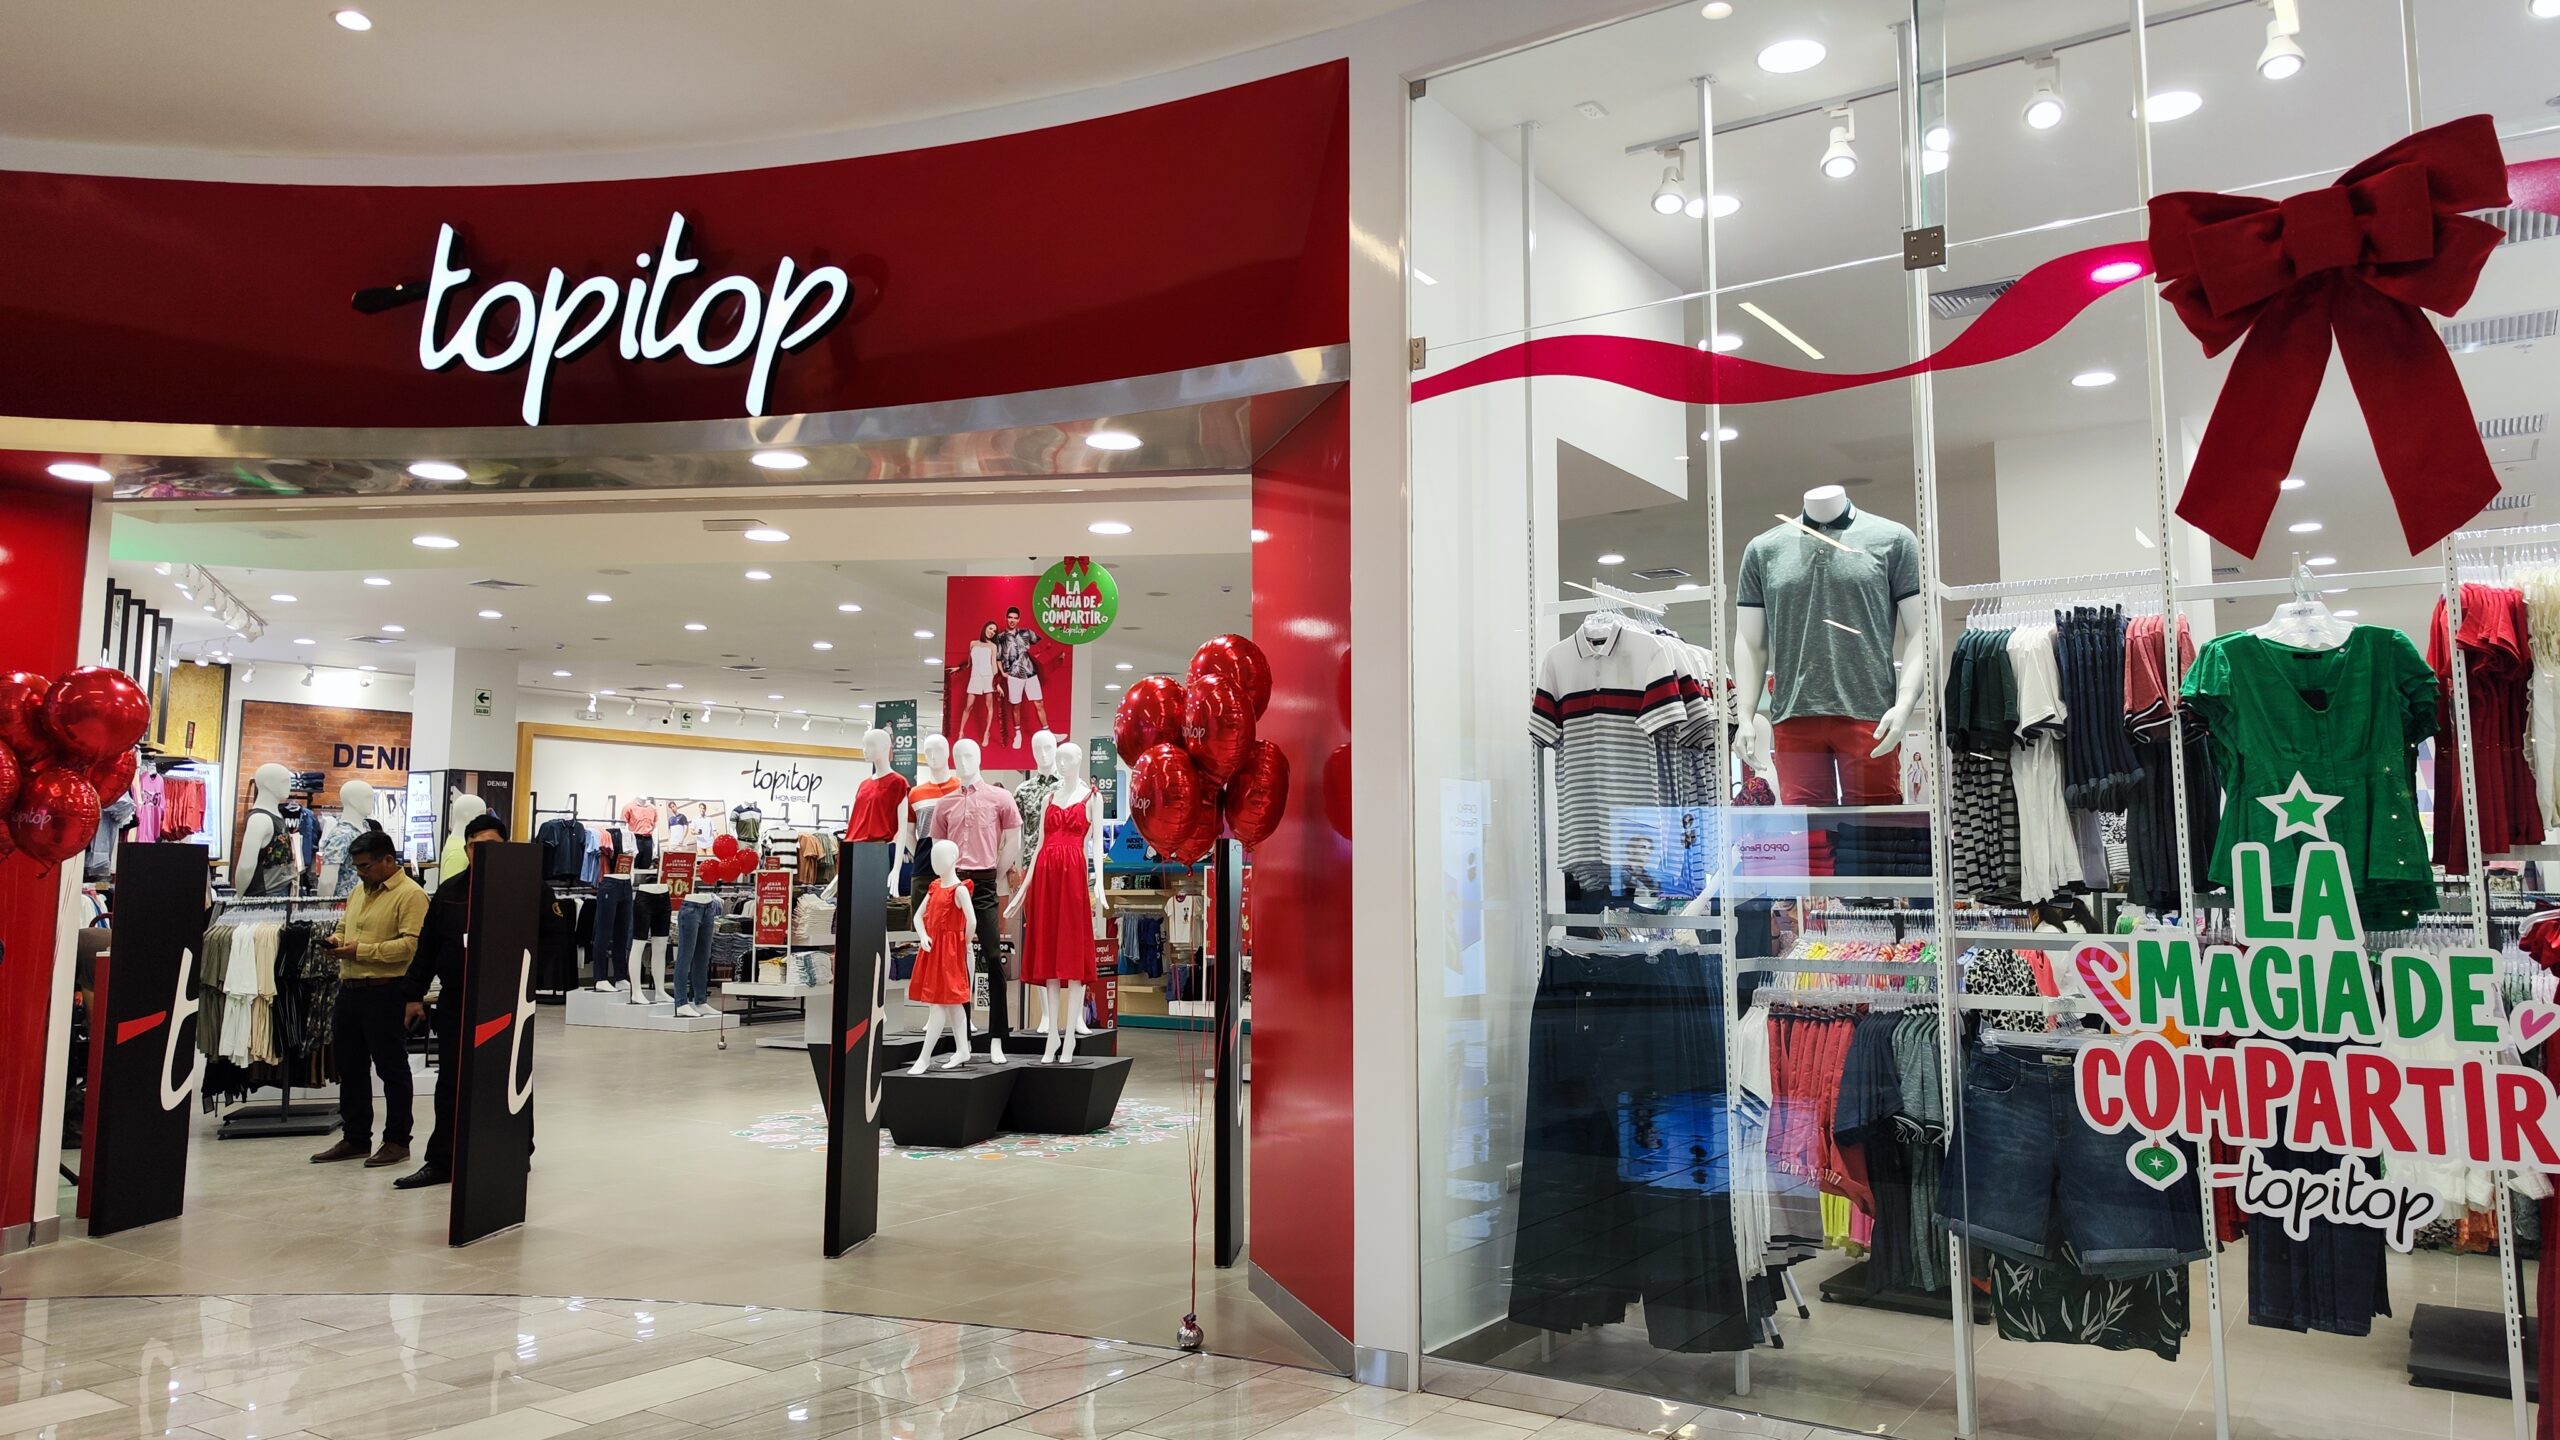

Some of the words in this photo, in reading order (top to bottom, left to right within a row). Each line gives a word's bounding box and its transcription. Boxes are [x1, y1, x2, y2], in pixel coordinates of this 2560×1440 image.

[419, 211, 849, 427] topitop
[1050, 594, 1082, 609] MAGIA
[1083, 595, 1097, 608] DE
[1065, 580, 1081, 595] LA
[1042, 609, 1102, 625] COMPARTIR
[333, 743, 411, 771] DENI
[753, 759, 823, 804] topitop
[761, 905, 787, 928] 50%
[2239, 848, 2355, 941] LA
[2136, 940, 2376, 1036] MAGIA
[2390, 955, 2500, 1043] DE
[2082, 1040, 2560, 1165] COMPARTIR
[2244, 1153, 2435, 1246] topitop
